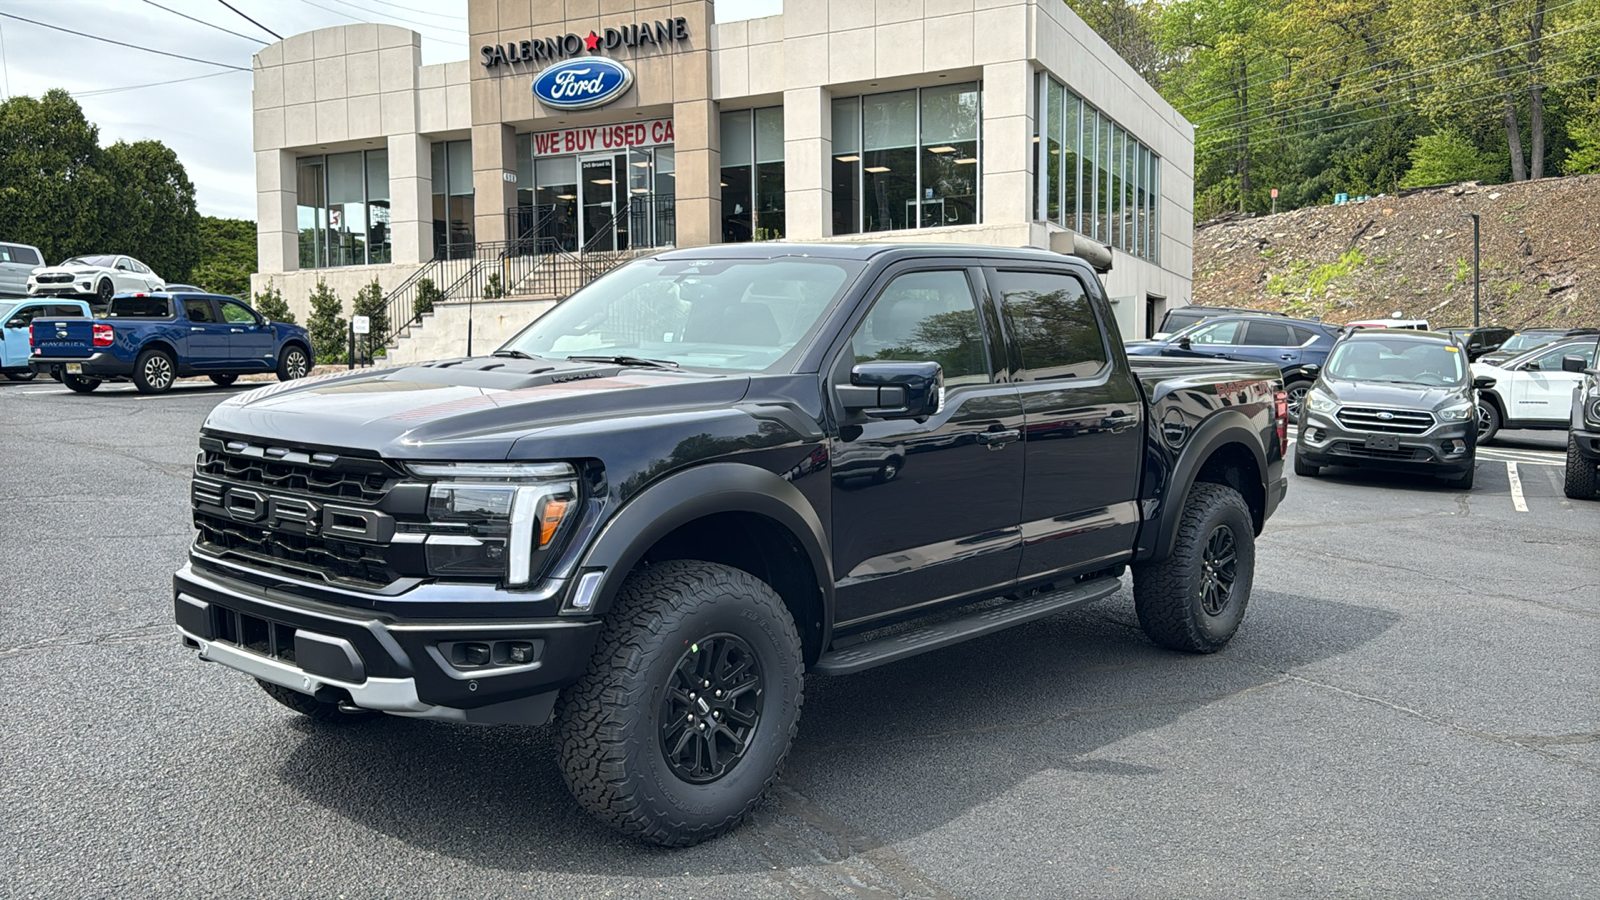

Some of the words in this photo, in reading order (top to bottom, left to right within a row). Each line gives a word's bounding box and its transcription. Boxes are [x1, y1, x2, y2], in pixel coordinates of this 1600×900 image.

[481, 33, 584, 68] SALERNO
[604, 17, 687, 50] DUANE
[551, 68, 604, 99] Ford
[535, 132, 560, 154] WE
[565, 128, 598, 151] BUY
[602, 123, 646, 148] USED
[1215, 380, 1273, 403] RAPTOR
[192, 478, 395, 548] FORD
